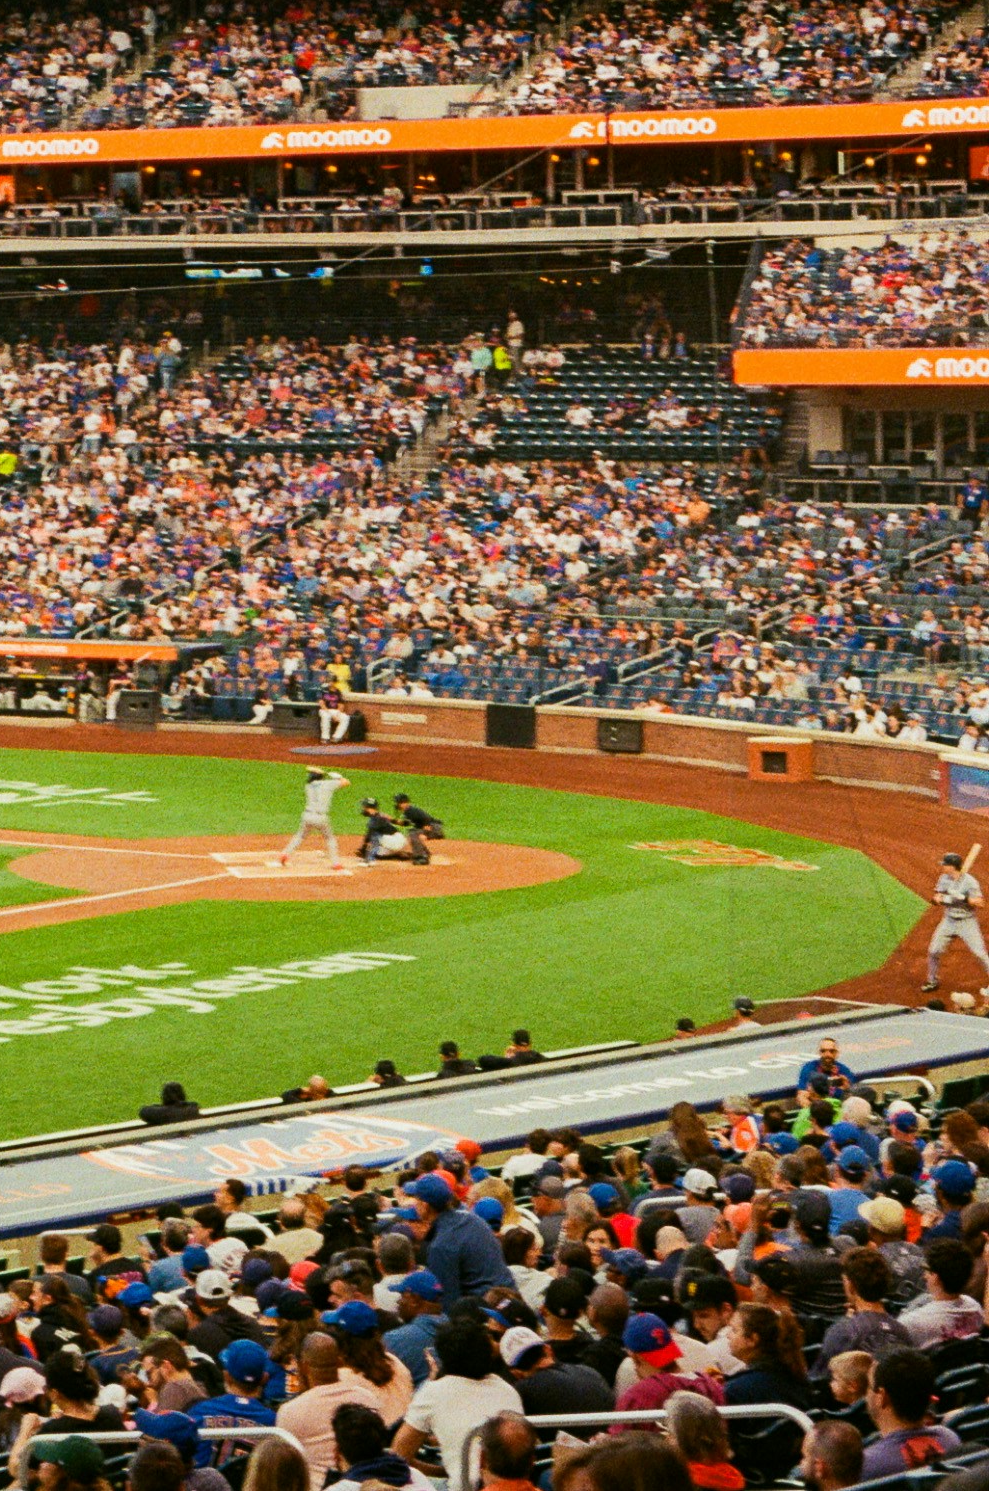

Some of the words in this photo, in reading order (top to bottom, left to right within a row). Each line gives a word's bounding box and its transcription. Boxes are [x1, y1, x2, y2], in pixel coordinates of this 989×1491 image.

[287, 129, 391, 148] moomoo
[598, 118, 716, 139] moomoo
[2, 138, 99, 157] moomoo
[476, 1075, 694, 1116] welcome
[695, 1064, 748, 1081] to
[204, 1128, 409, 1177] Mets
